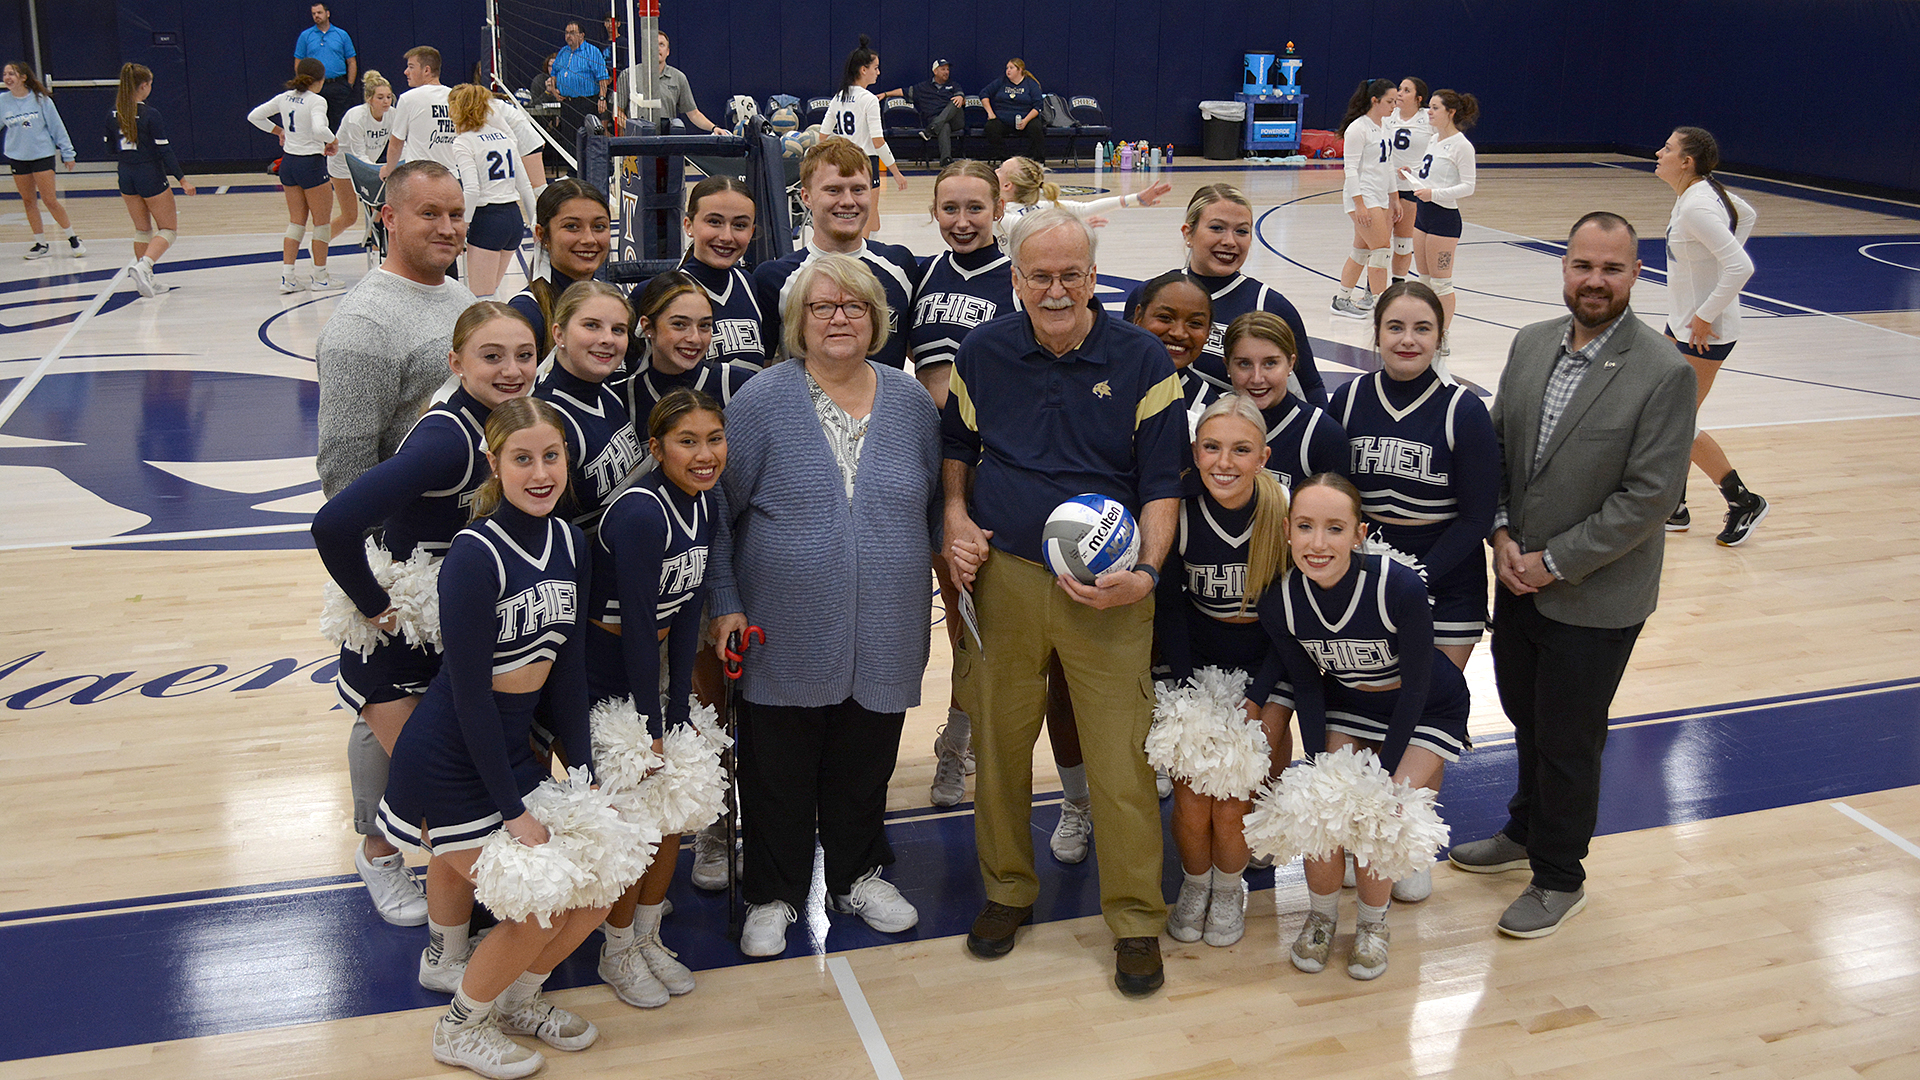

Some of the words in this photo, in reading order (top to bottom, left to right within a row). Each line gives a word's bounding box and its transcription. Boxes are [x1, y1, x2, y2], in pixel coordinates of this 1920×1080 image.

[285, 95, 305, 105] THIEL
[811, 99, 834, 109] THIE
[836, 95, 856, 103] TIEL
[288, 110, 297, 133] 1
[836, 111, 856, 136] 18
[477, 132, 507, 142] THIEL
[1393, 128, 1412, 151] 6
[486, 149, 515, 181] 21
[1418, 153, 1434, 180] 3
[911, 291, 998, 330] THIEL
[705, 318, 766, 361] HIEL
[584, 421, 644, 499] THIE
[1348, 435, 1449, 487] THIEL
[1088, 505, 1122, 552] molten
[1104, 518, 1134, 563] NCAA
[1184, 558, 1249, 599] THI
